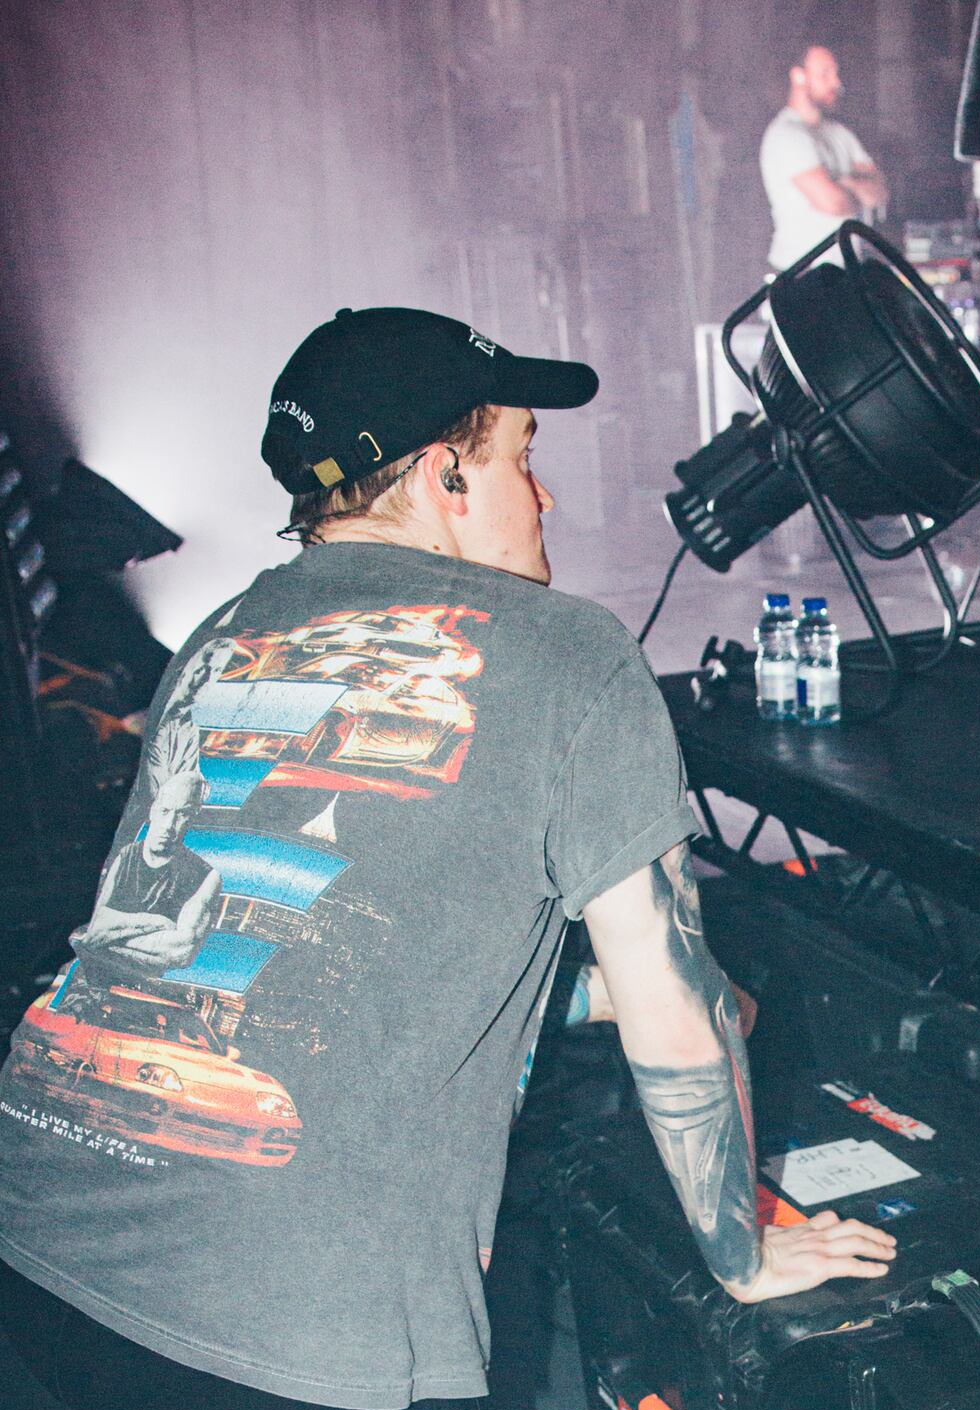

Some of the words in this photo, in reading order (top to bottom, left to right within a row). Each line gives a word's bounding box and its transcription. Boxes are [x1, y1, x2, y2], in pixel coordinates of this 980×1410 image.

[288, 401, 315, 433] BAND
[0, 1101, 48, 1130] QUARTER
[52, 1125, 84, 1143] MILE
[86, 1139, 102, 1151] AT
[105, 1146, 115, 1157] A
[41, 1112, 70, 1130] LIVE
[73, 1124, 93, 1137] MY
[96, 1133, 127, 1151] LIFE
[129, 1144, 138, 1154] A
